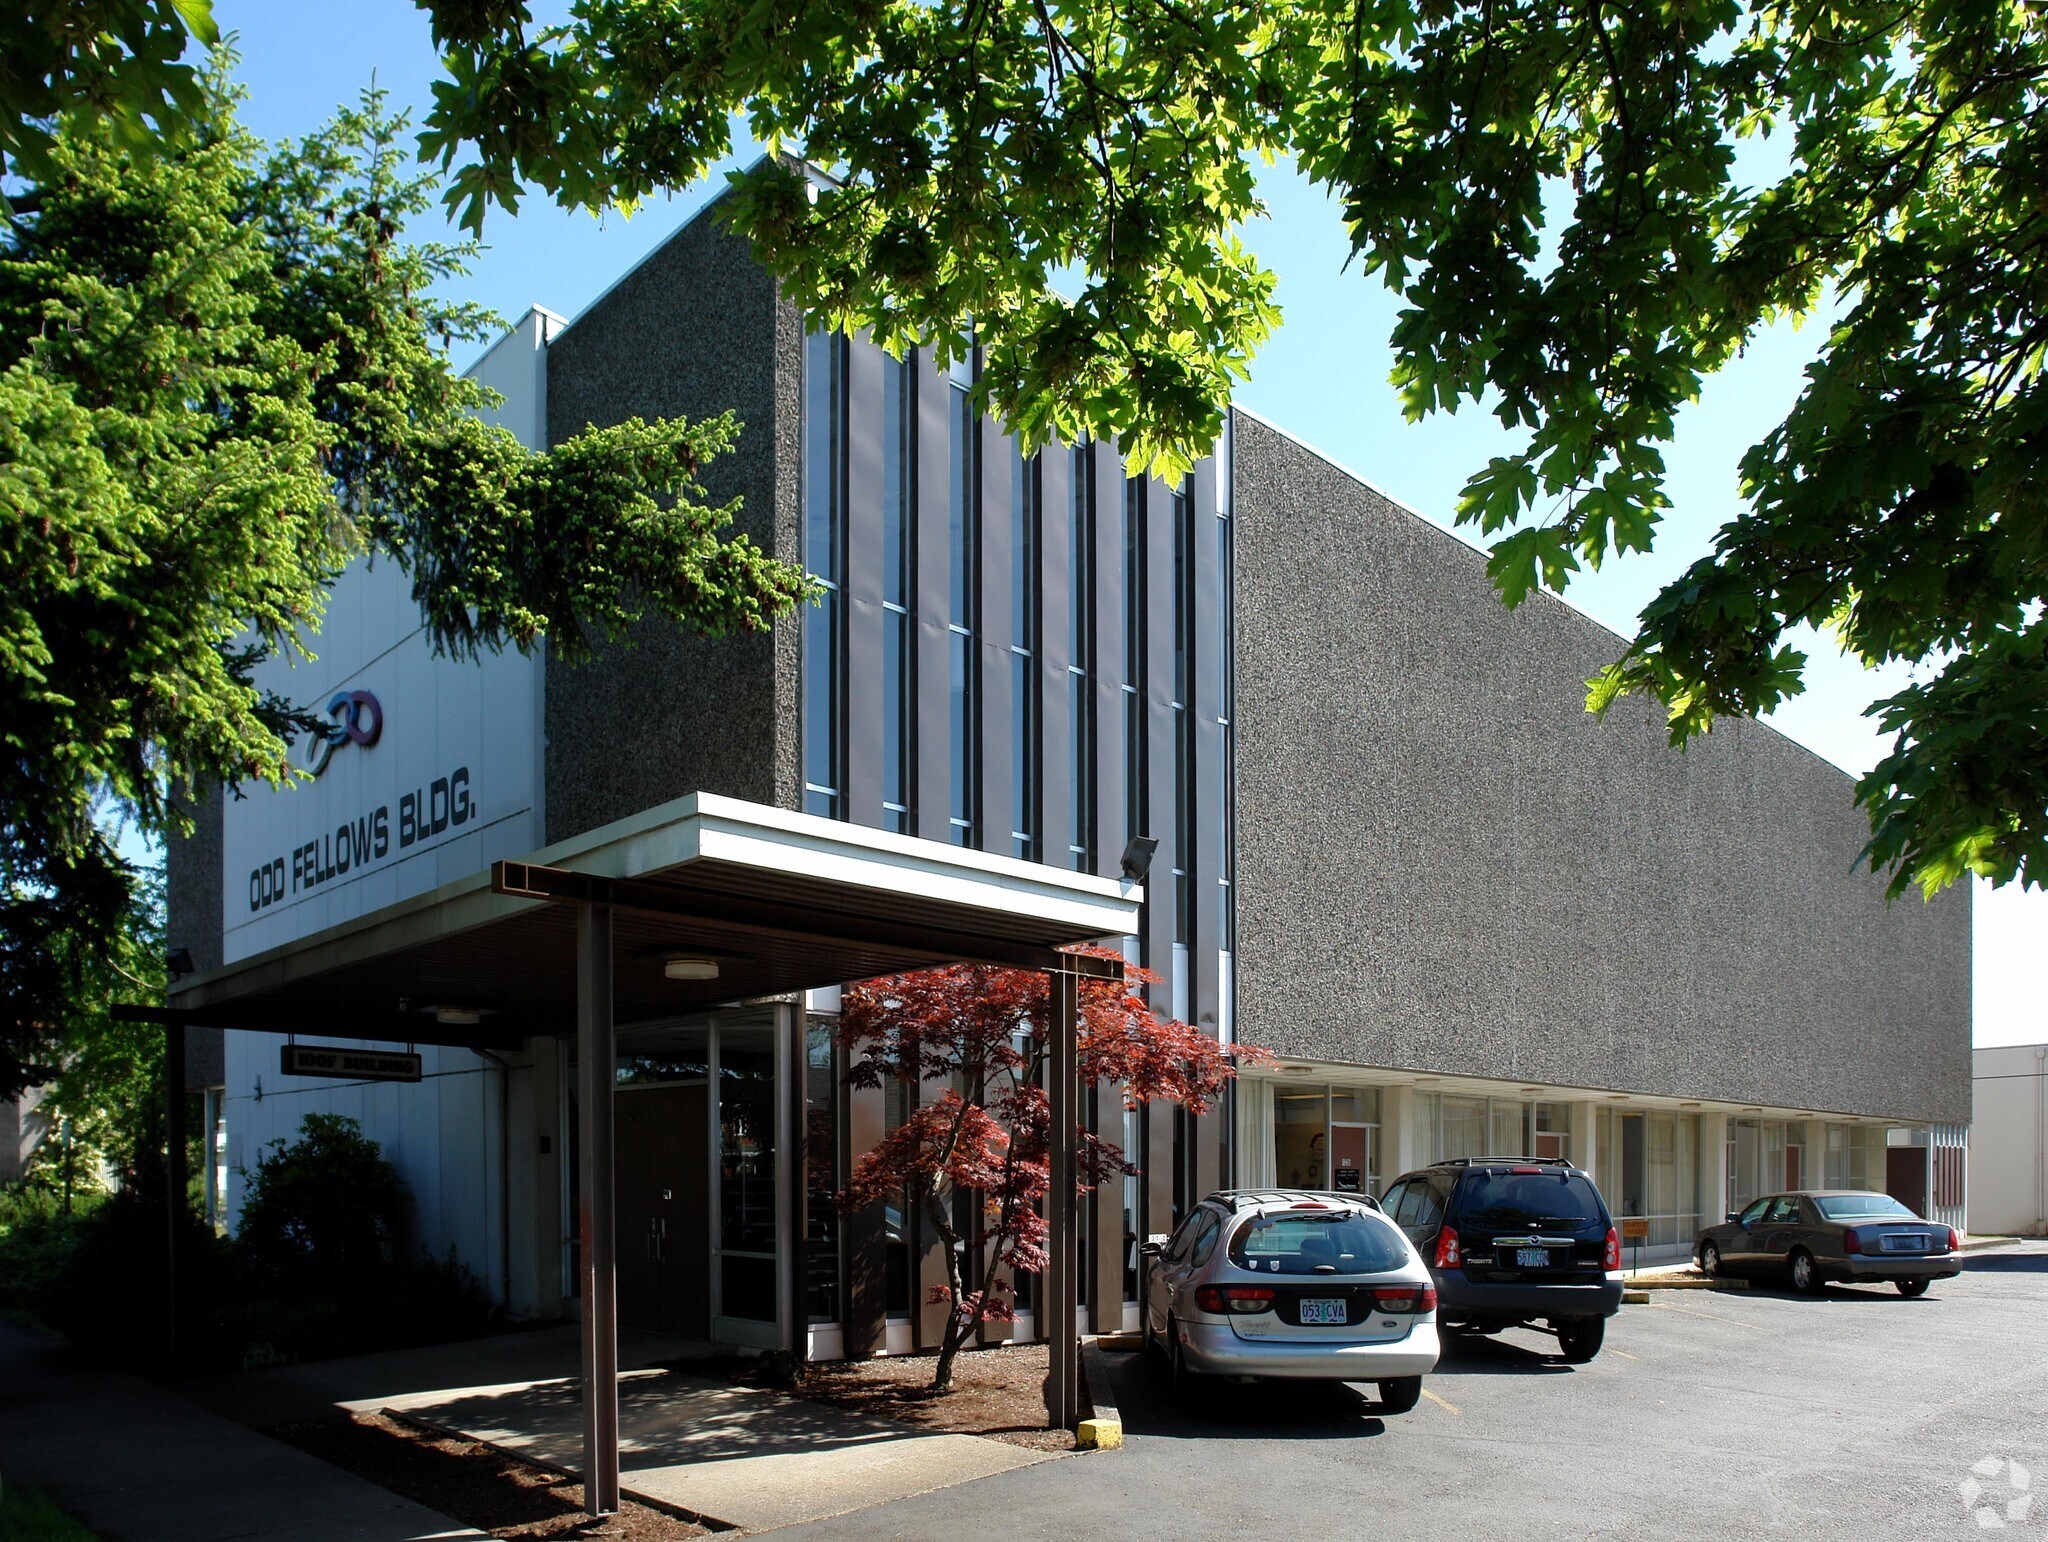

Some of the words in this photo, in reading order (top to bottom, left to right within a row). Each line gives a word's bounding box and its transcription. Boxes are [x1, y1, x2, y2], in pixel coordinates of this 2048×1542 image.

[250, 857, 285, 912] ODD
[292, 805, 389, 894] FELLOWS
[399, 766, 476, 849] BLDG.
[343, 1056, 414, 1074] BUILDING
[1302, 1304, 1321, 1318] 053
[1326, 1304, 1345, 1318] CVA
